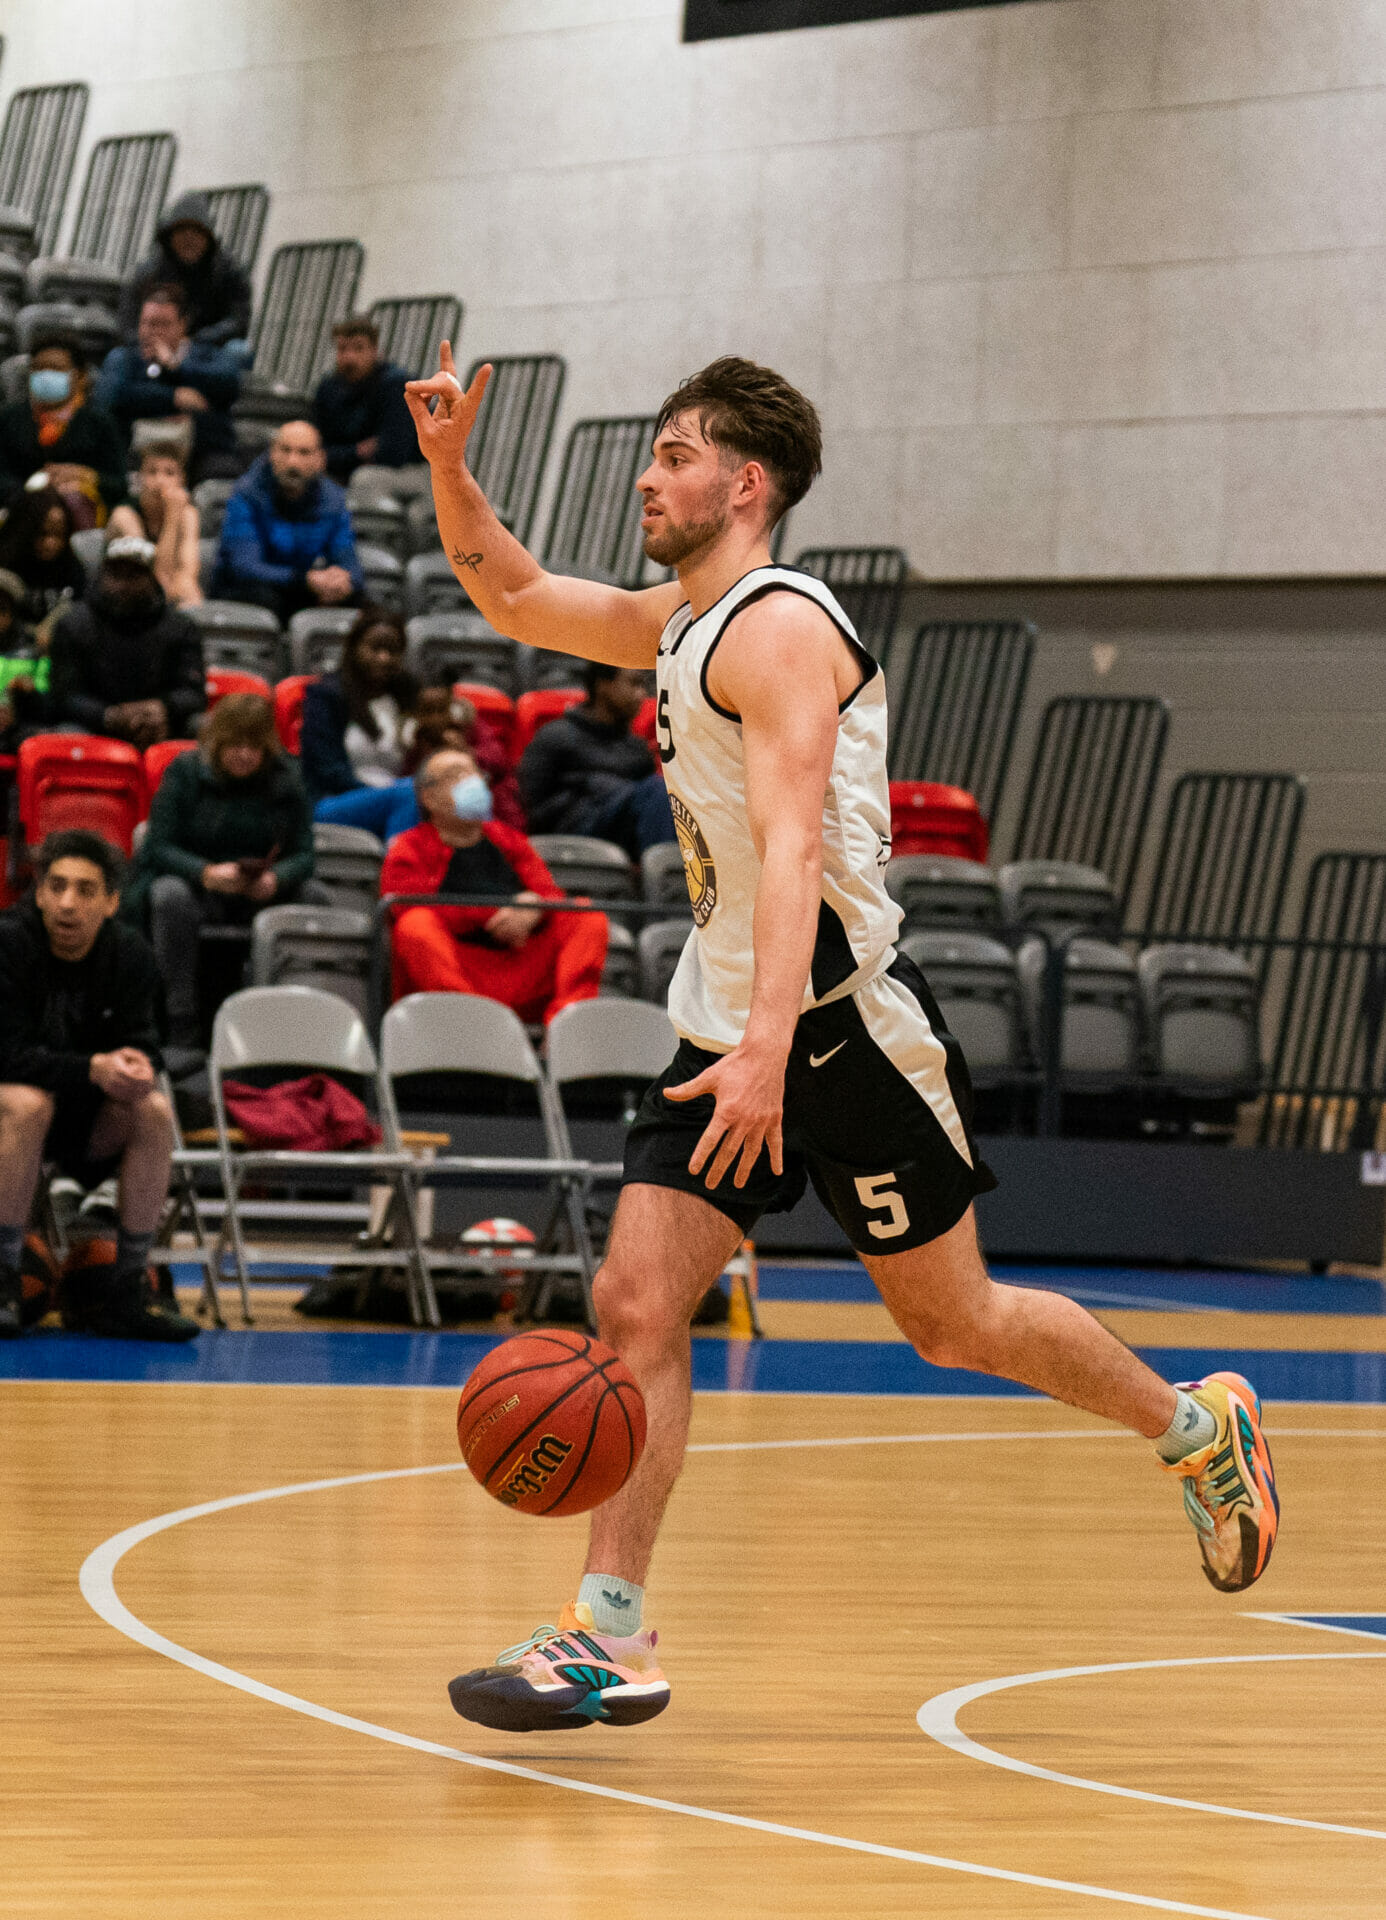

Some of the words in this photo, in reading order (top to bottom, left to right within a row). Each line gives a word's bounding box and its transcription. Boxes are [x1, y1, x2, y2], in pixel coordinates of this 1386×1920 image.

[658, 688, 677, 763] 5
[700, 886, 715, 917] CLUB
[854, 1172, 911, 1240] 5
[499, 1433, 575, 1504] Wilso
